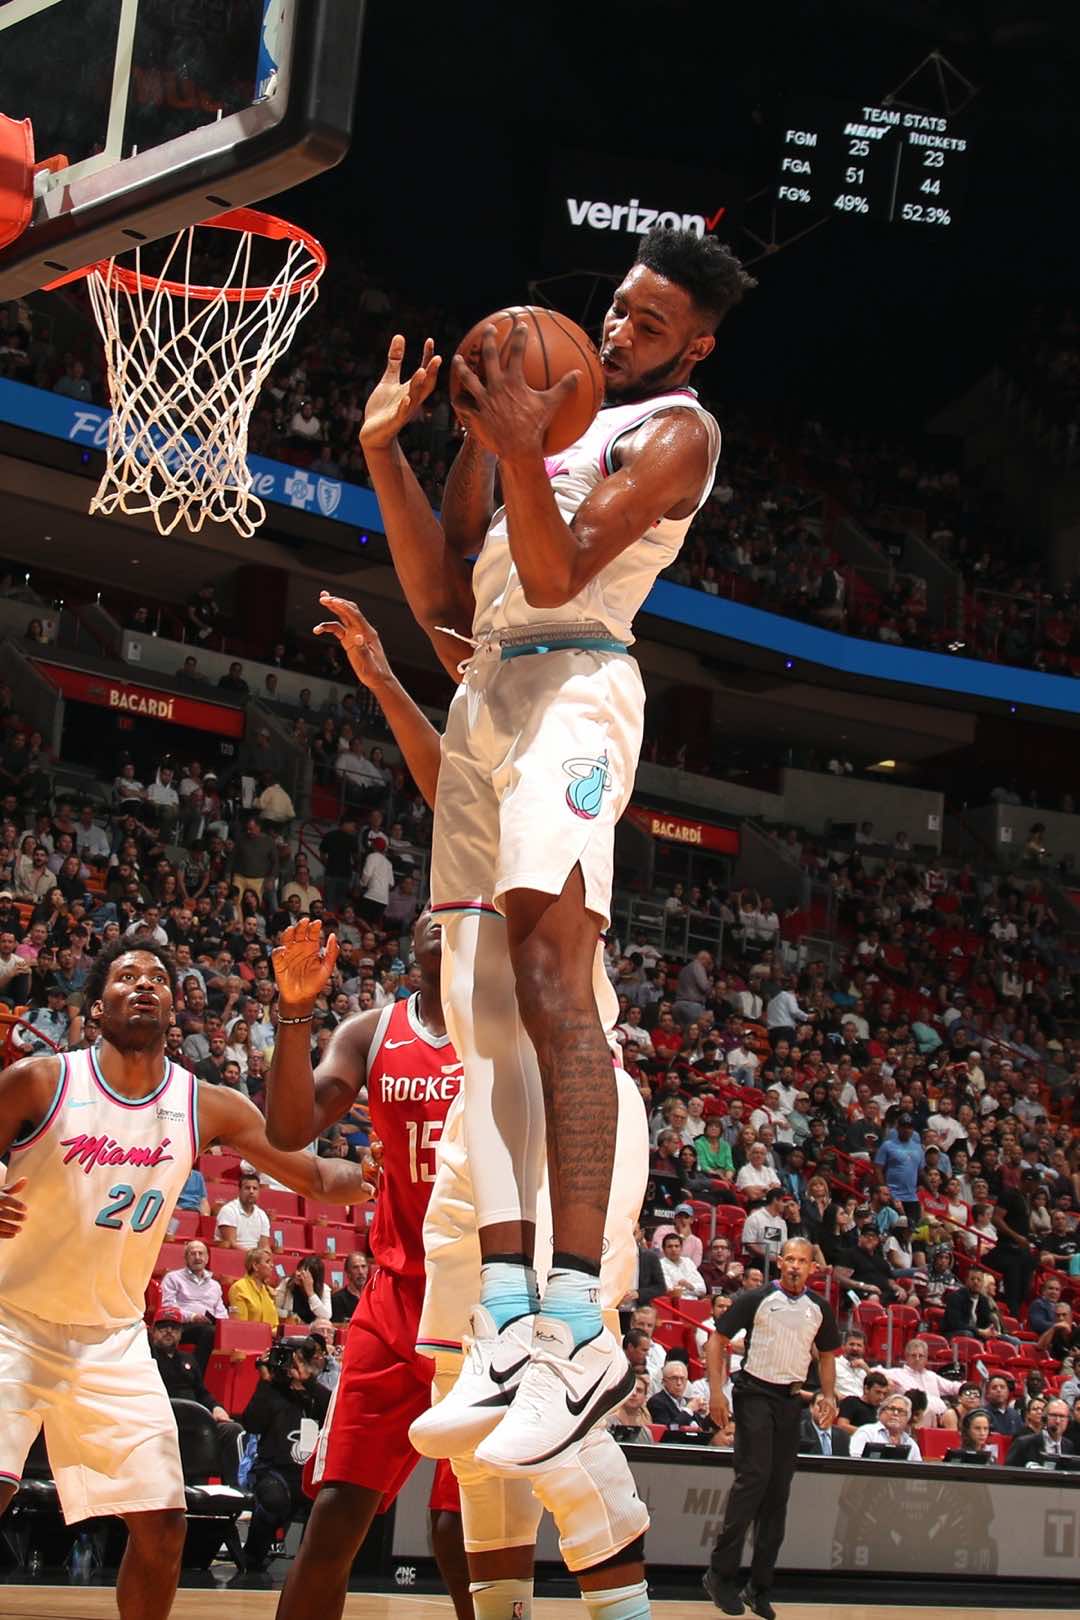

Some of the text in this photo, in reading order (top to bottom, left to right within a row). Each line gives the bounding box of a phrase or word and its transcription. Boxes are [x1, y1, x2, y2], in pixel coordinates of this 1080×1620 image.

[863, 107, 947, 132] TEAM STATS
[785, 130, 817, 147] FGM
[844, 123, 891, 140] HEAT
[848, 139, 870, 157] 25
[909, 132, 967, 151] ROCKETS
[781, 158, 812, 175] FGA
[923, 150, 945, 168] 23
[845, 167, 865, 184] 51
[778, 185, 811, 203] FG%
[920, 178, 941, 195] 44
[833, 194, 870, 214] 49%
[567, 198, 706, 240] verizon
[901, 203, 952, 226] 52.3%
[109, 689, 174, 720] BACARDÍ
[60, 1133, 173, 1174] Miami
[406, 1120, 443, 1184] 15
[95, 1183, 165, 1233] 20
